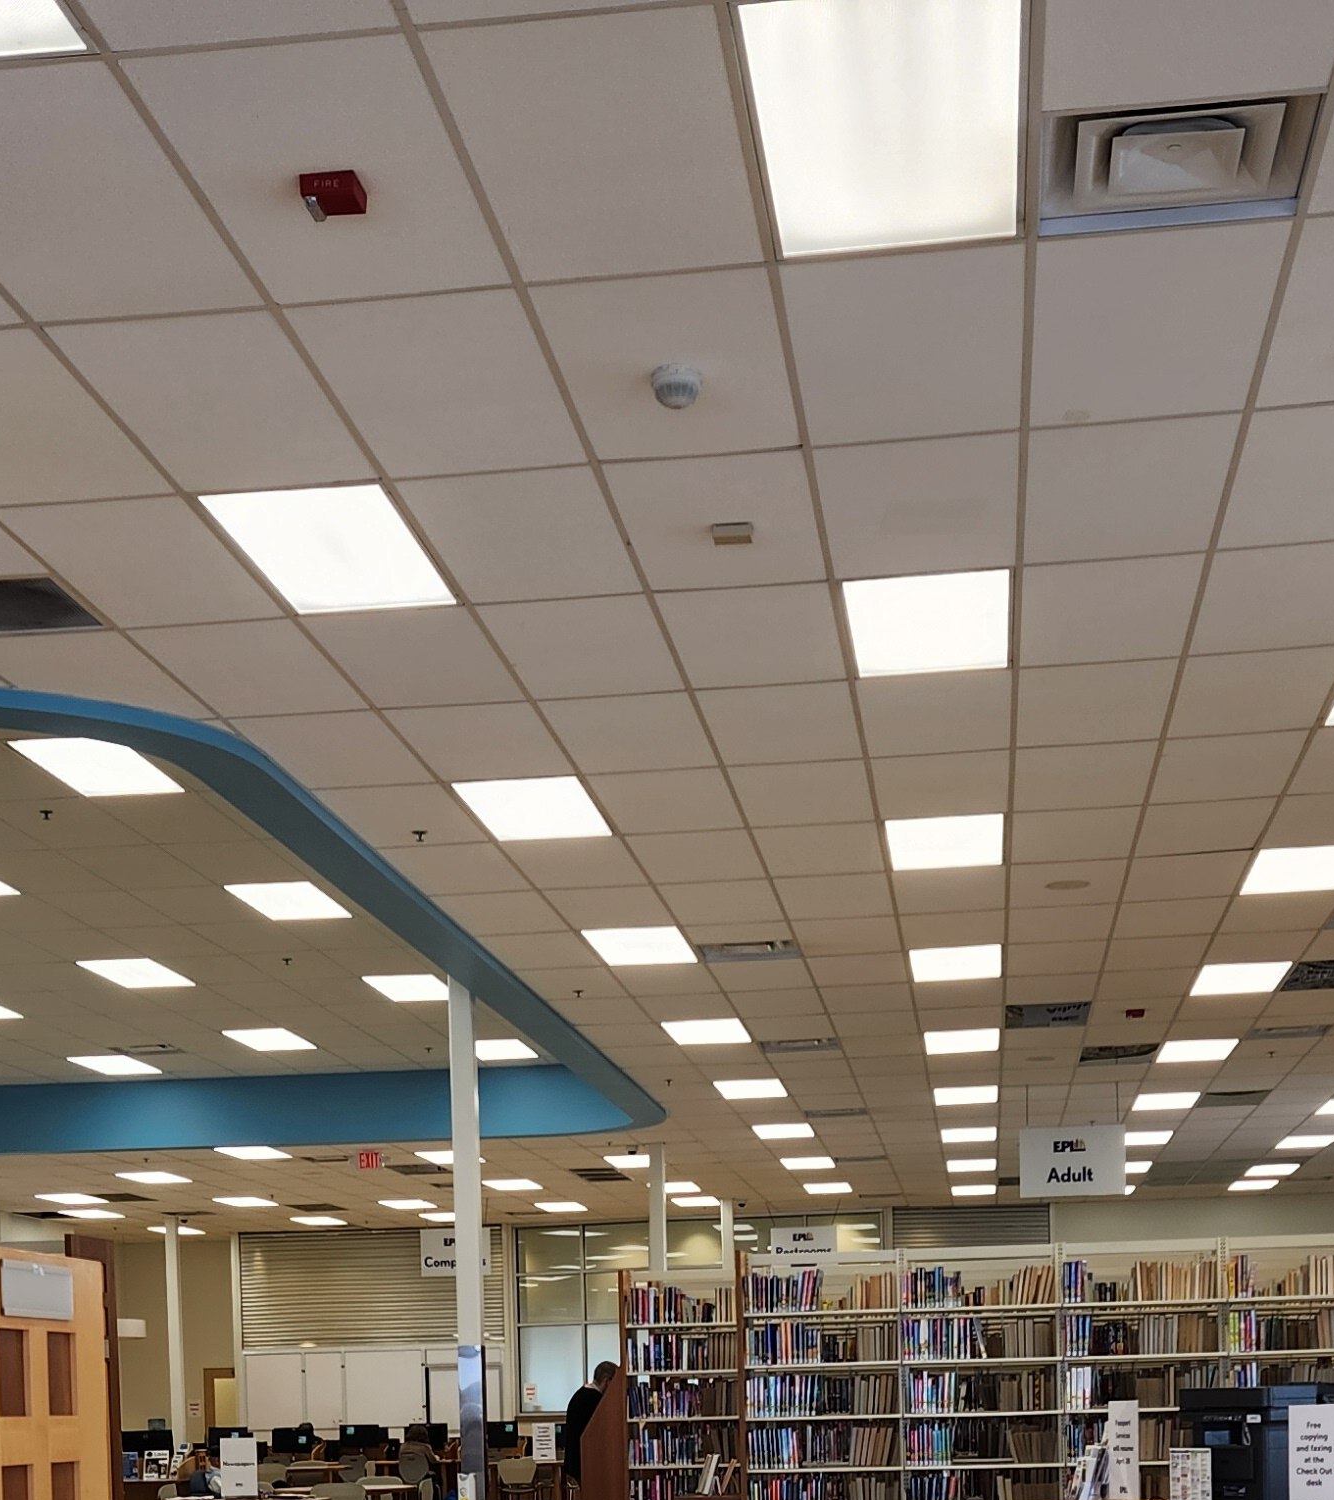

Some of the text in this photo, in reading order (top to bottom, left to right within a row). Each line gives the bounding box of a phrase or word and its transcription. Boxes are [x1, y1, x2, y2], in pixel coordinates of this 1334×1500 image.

[313, 179, 340, 188] FIRE
[1053, 1140, 1086, 1153] EPL
[359, 1152, 379, 1168] EXIT
[1047, 1166, 1093, 1183] Adult
[1300, 1434, 1328, 1442] copying
[1311, 1445, 1332, 1453] faxing
[1296, 1467, 1332, 1475] Check Out
[1306, 1479, 1322, 1487] desk
